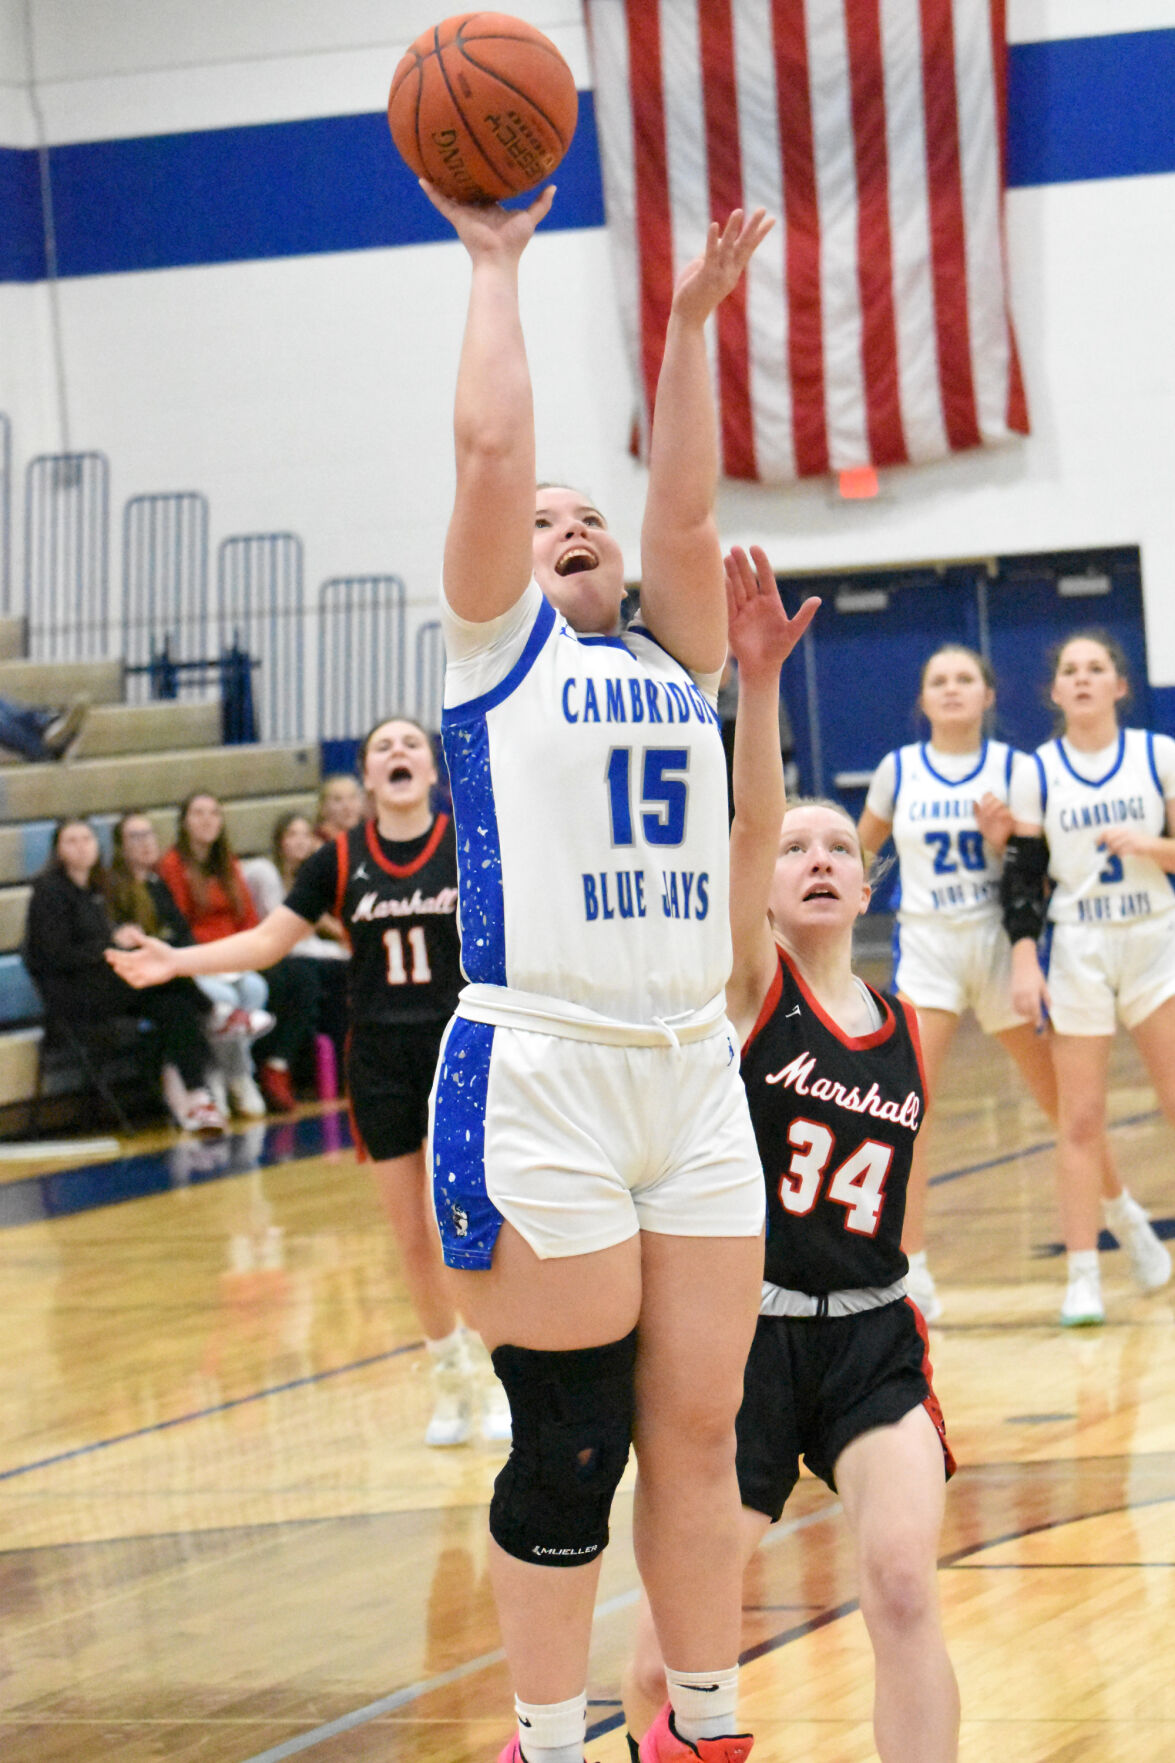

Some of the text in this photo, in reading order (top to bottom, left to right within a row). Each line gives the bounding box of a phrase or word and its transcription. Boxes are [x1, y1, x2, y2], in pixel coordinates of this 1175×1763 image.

[603, 745, 691, 849] 15
[1059, 797, 1146, 832] CAMBRIDGE
[924, 830, 986, 875] 20
[351, 887, 459, 924] Marshall
[582, 870, 709, 921] BLUE JAYS
[382, 926, 432, 985] 11
[764, 1050, 921, 1132] Marshall
[778, 1116, 895, 1239] 34
[540, 1544, 599, 1556] MUELLER
